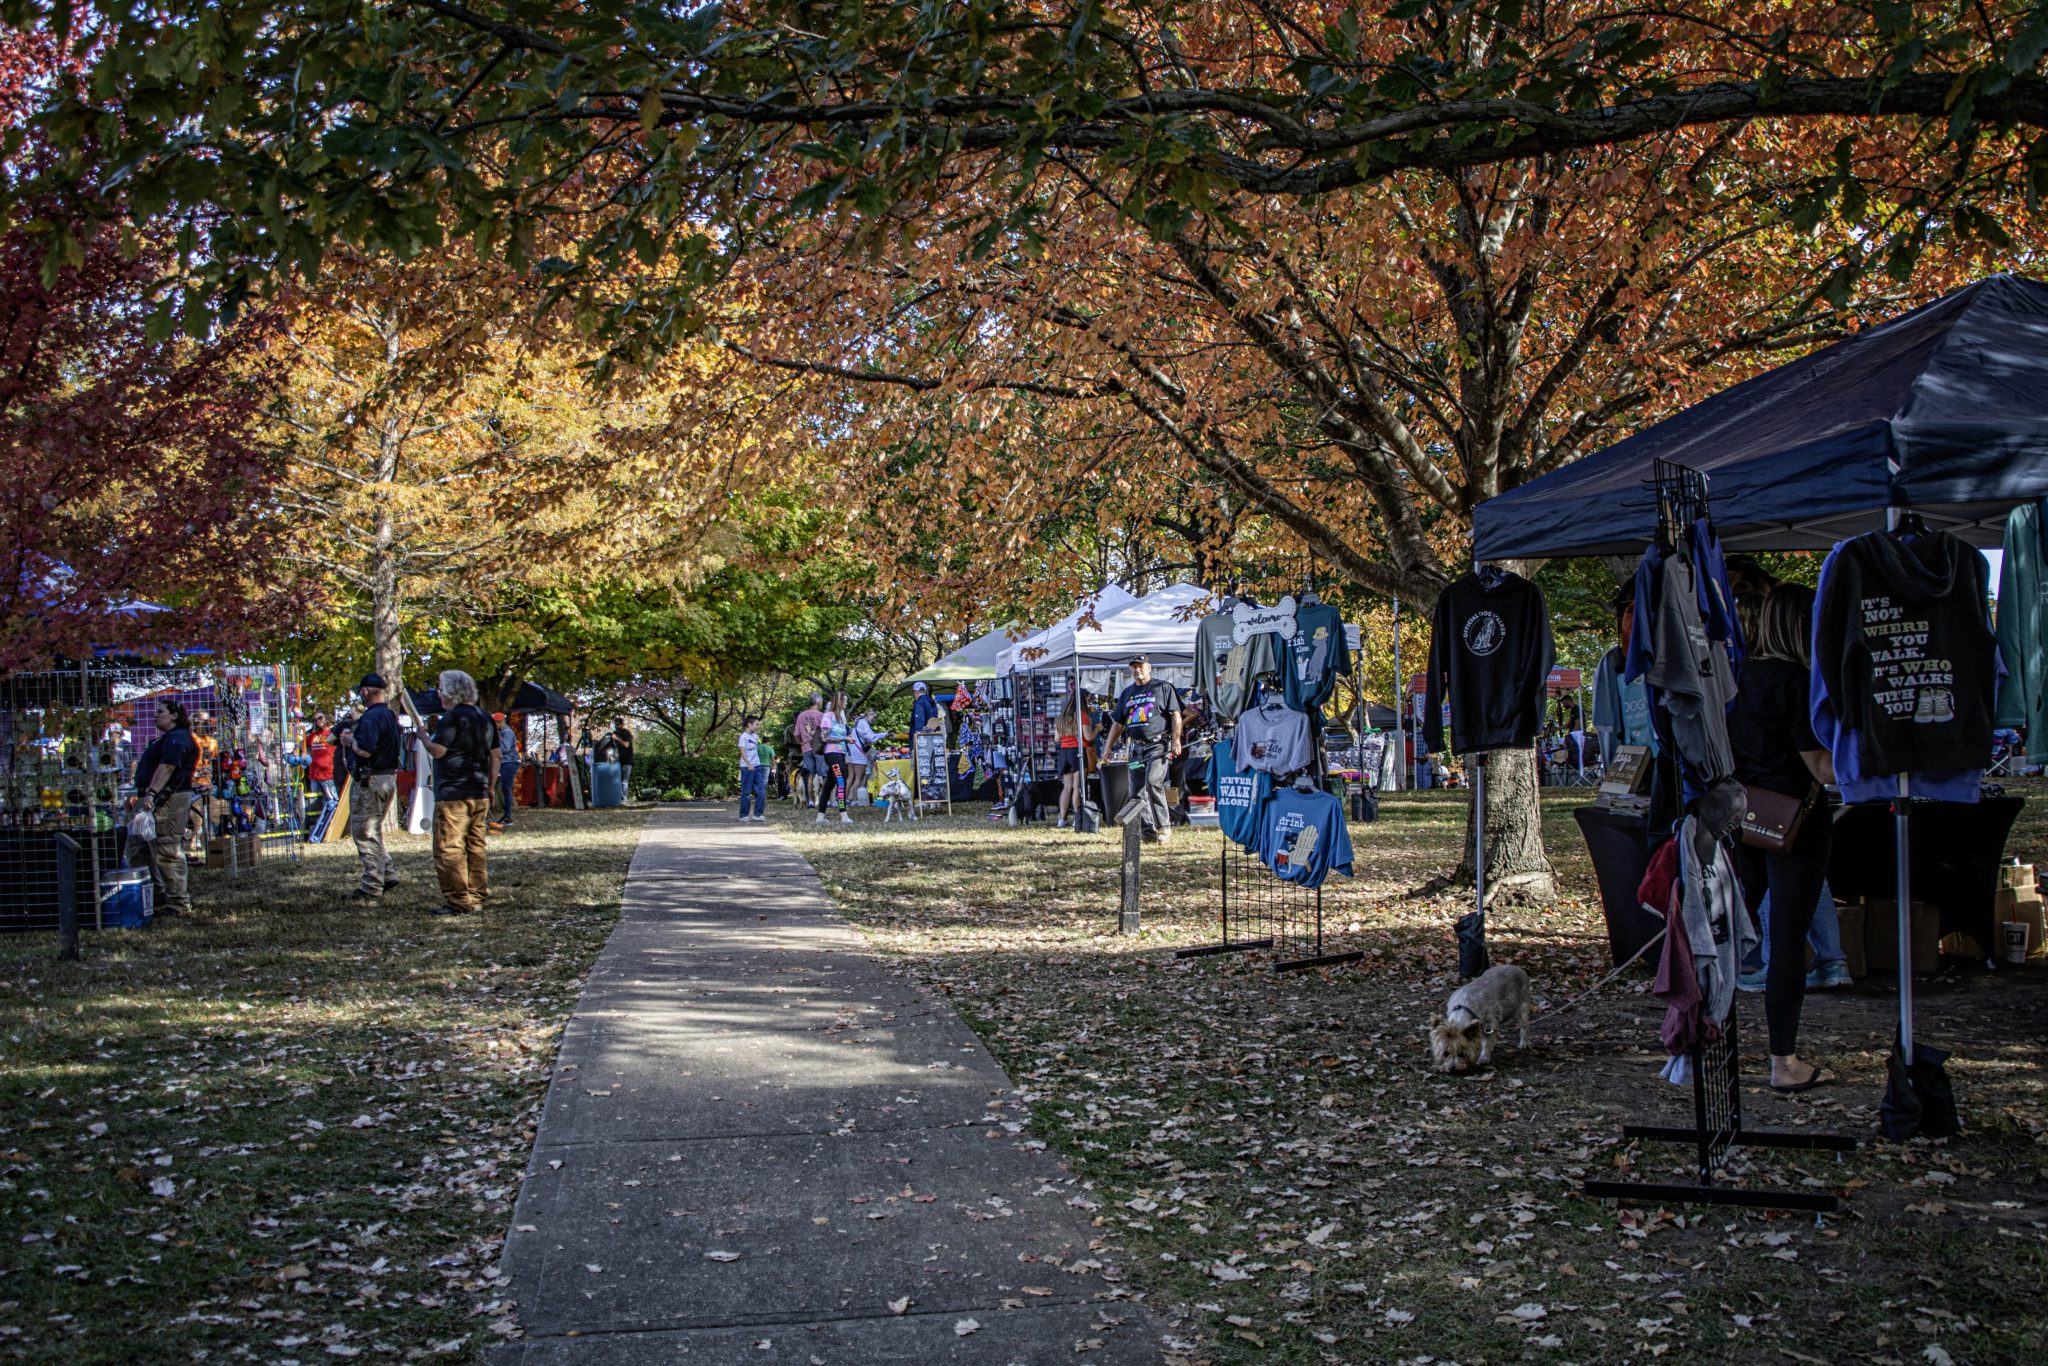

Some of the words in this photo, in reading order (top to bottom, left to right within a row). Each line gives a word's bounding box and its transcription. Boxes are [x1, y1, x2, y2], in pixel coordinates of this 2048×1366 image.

[1861, 596, 1890, 610] IT'S
[1241, 613, 1290, 626] welcome
[1864, 607, 1903, 623] NOT
[1463, 613, 1480, 638] OFFICIAL
[1864, 621, 1929, 637] WHERE
[1215, 640, 1232, 649] rink
[1889, 634, 1928, 647] YOU
[1874, 665, 1899, 677] IT'S
[1901, 659, 1952, 674] WHO
[1887, 673, 1953, 688] WALKS
[1873, 688, 1915, 704] WITH
[1884, 701, 1915, 715] YOU
[1220, 776, 1252, 785] NEVER
[1220, 785, 1251, 798] WALK
[1218, 798, 1249, 807] ALONE
[1279, 816, 1305, 828] drink
[2008, 932, 2023, 943] QT
